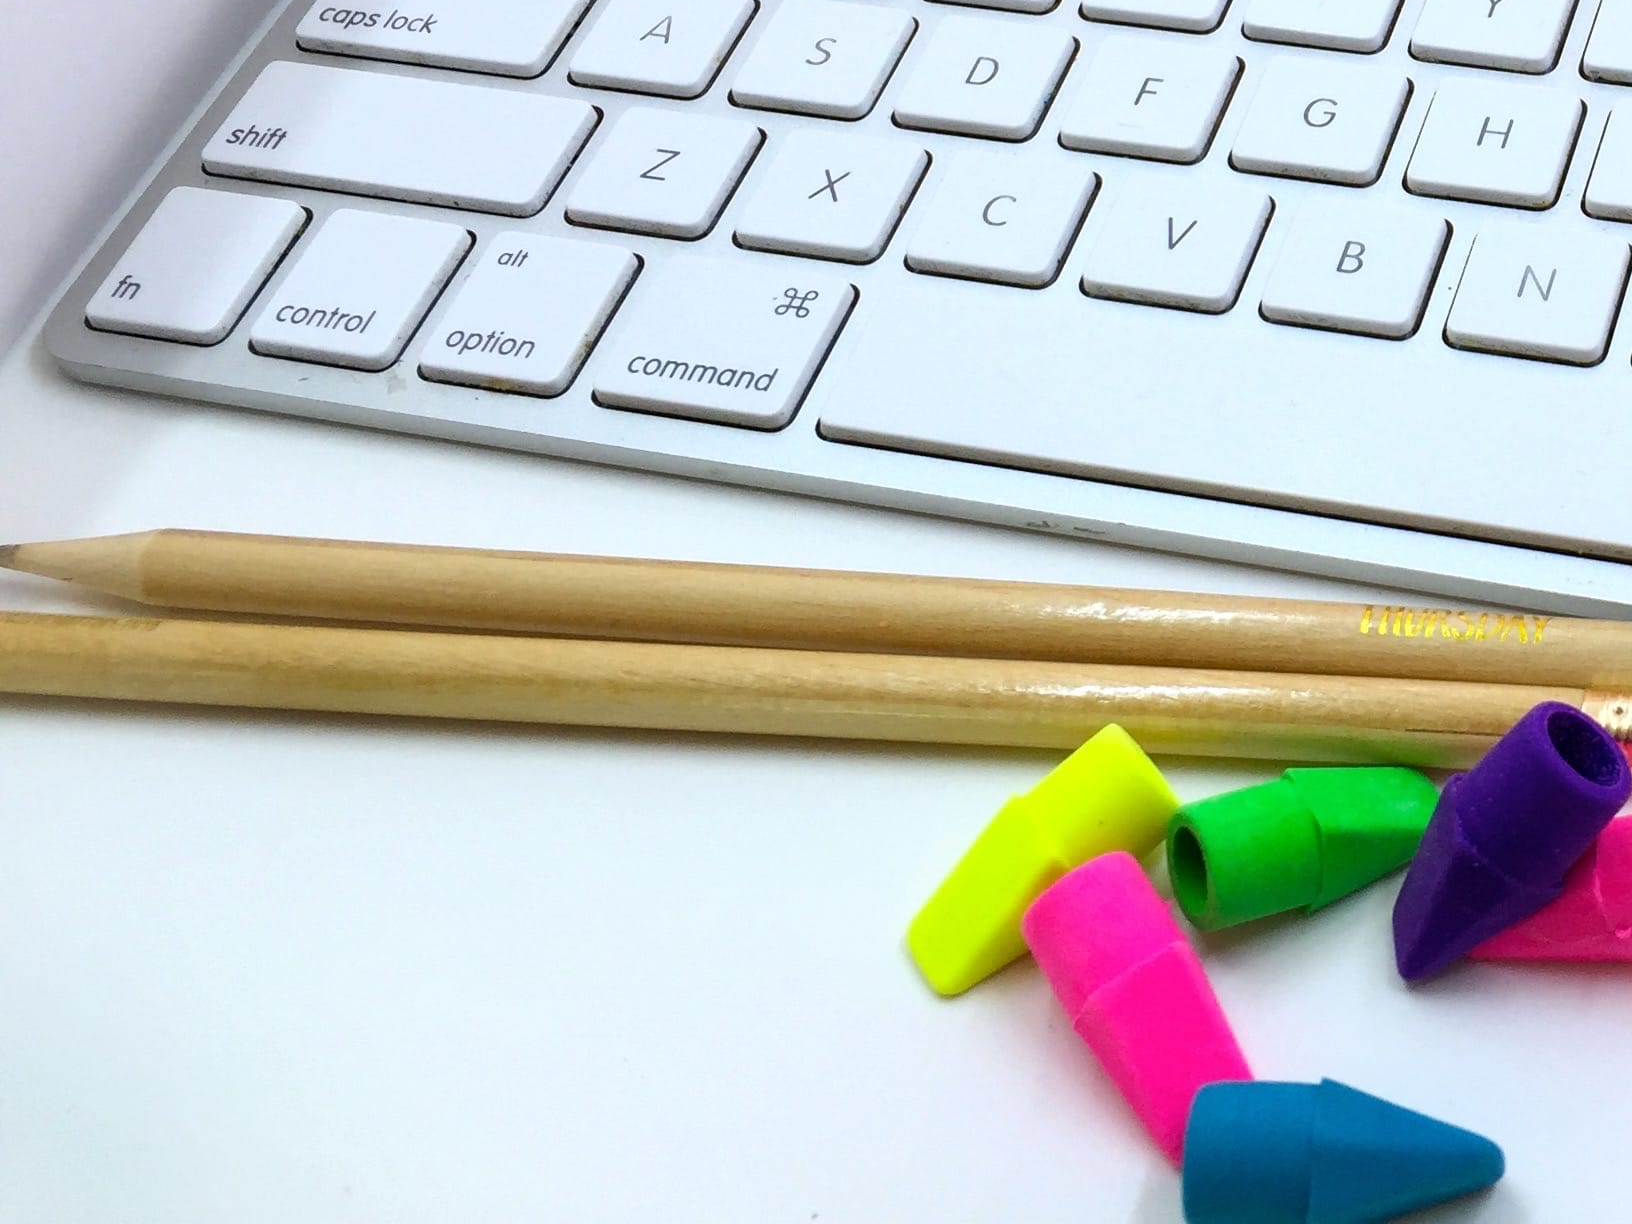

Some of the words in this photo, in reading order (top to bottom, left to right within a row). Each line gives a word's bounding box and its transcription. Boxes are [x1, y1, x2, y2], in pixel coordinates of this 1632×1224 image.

[317, 6, 382, 30] caps
[383, 9, 438, 35] lock
[639, 15, 672, 45] A
[805, 37, 837, 66] S
[965, 56, 999, 86] D
[1133, 77, 1164, 106] F
[1303, 98, 1338, 128] G
[225, 125, 288, 151] shift
[1476, 116, 1514, 150] H
[639, 148, 681, 181] Z
[807, 168, 851, 203] X
[982, 195, 1017, 227] C
[1167, 216, 1198, 251] V
[497, 249, 529, 268] alt
[1335, 240, 1366, 274] B
[111, 276, 142, 301] fn
[1516, 264, 1557, 302] N
[274, 303, 377, 335] control
[445, 330, 536, 359] option
[626, 354, 780, 394] command
